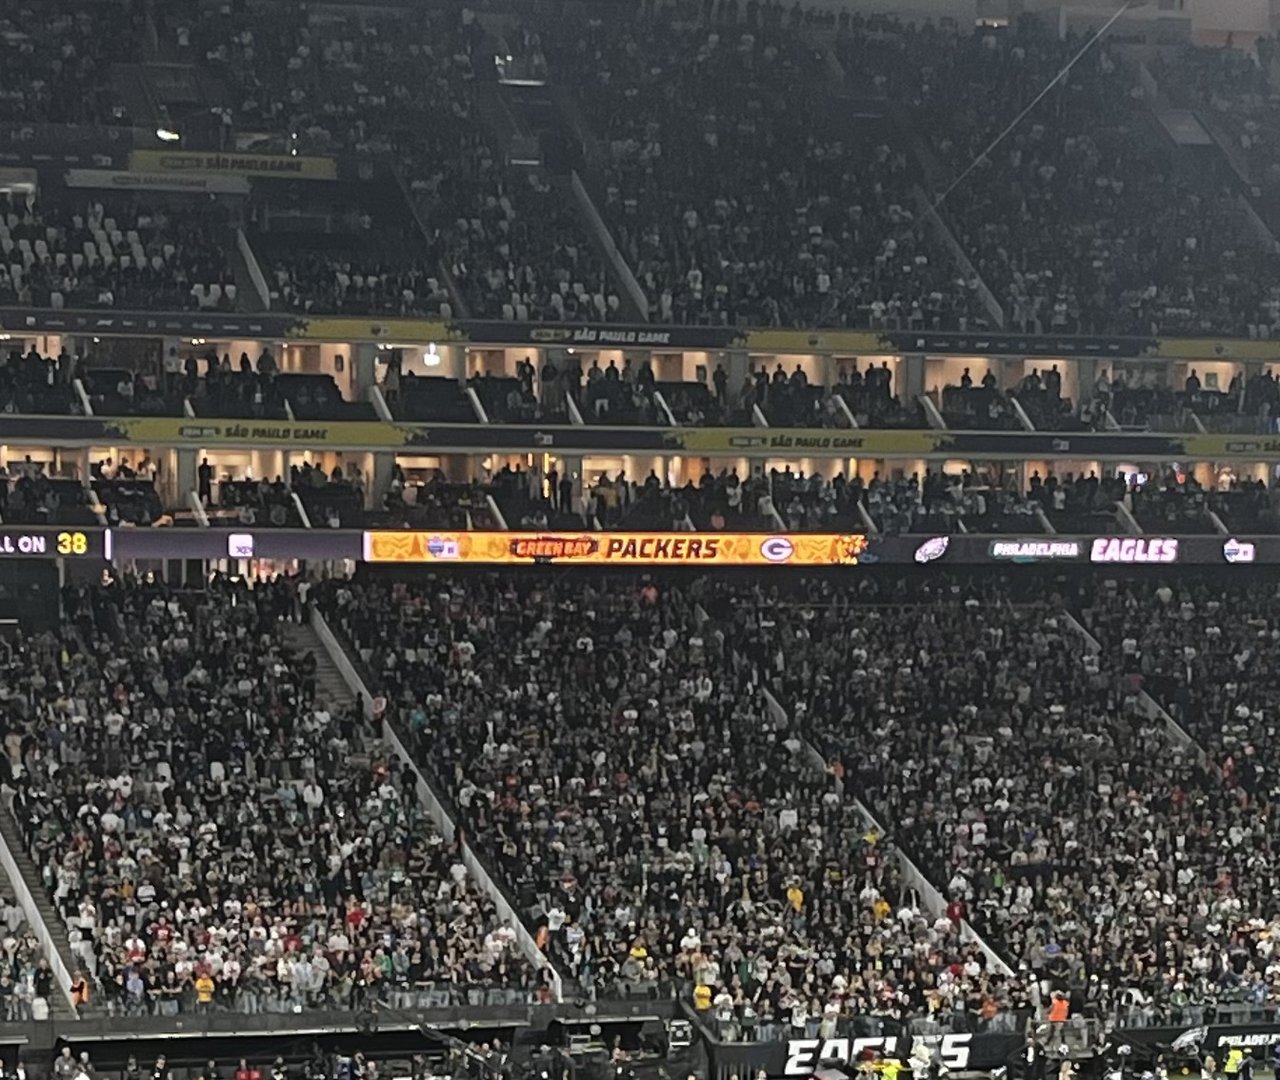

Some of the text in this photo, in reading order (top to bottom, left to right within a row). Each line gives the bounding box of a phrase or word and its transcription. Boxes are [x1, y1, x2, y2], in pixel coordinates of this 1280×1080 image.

[17, 534, 46, 553] ON
[56, 532, 87, 554] 38
[564, 538, 593, 557] BAY
[606, 538, 721, 560] PACKERS
[993, 539, 1179, 564] PHILADELPHIA EAGLES
